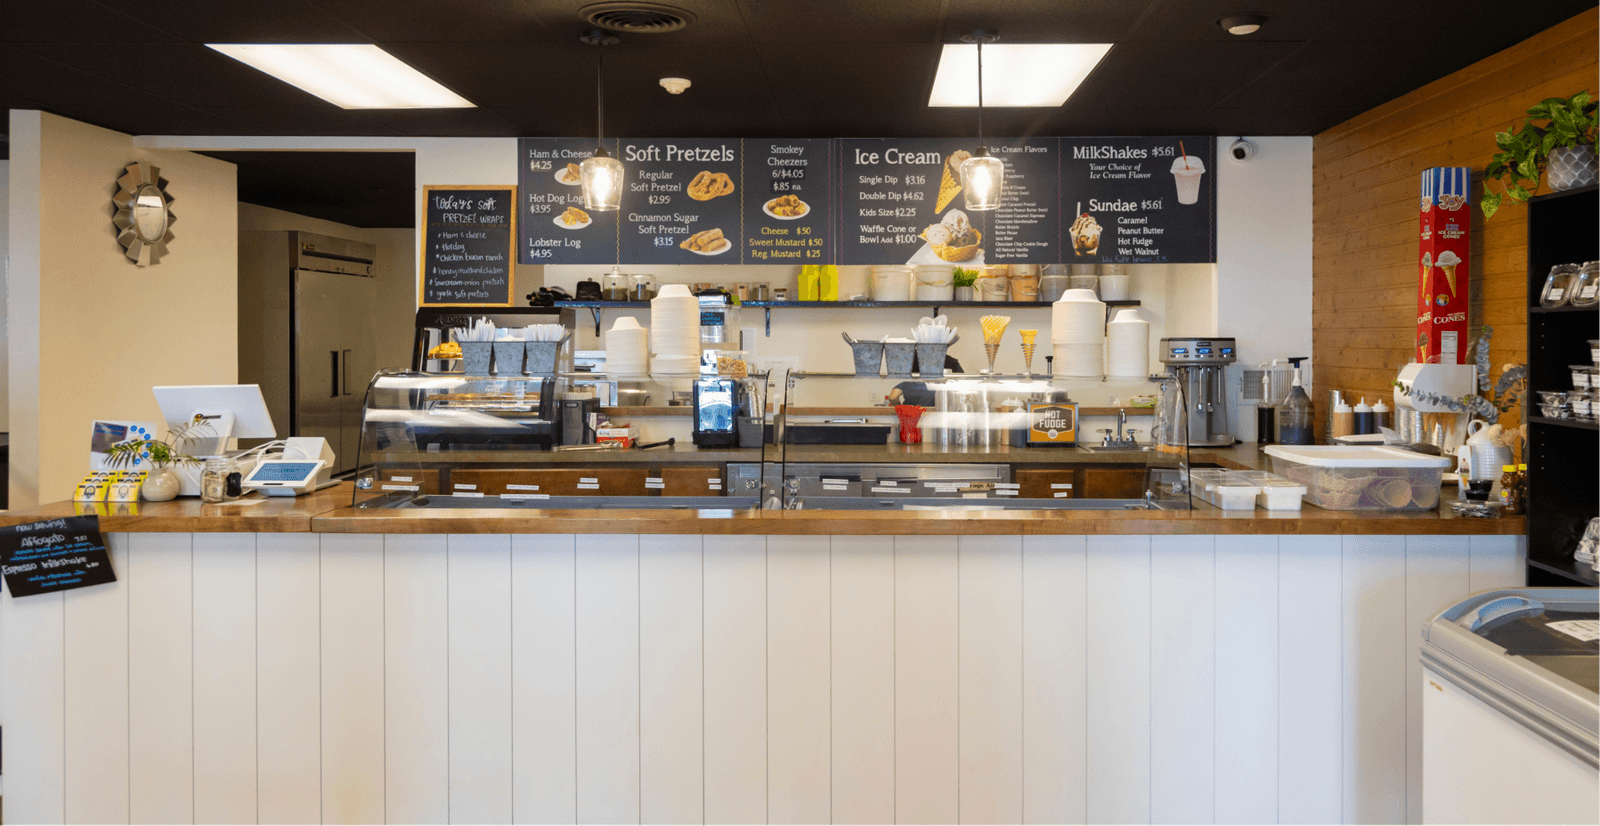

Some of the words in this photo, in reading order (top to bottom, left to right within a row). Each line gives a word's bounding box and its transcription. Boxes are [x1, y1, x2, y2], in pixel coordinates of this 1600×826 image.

[530, 150, 550, 158] Ham
[552, 150, 559, 158] &
[560, 150, 592, 158] Cheese
[626, 145, 660, 161] Soft
[666, 145, 734, 161] Pretzels
[770, 145, 804, 156] Smokey
[1073, 146, 1147, 159] MilkShakes
[1152, 146, 1175, 157] $5.61
[855, 149, 879, 164] Ice
[885, 148, 941, 164] Cream
[530, 161, 552, 170] $4.25
[767, 157, 808, 166] Cheezers
[1134, 163, 1142, 171] of
[639, 171, 673, 181] Regular
[772, 169, 804, 179] 6/$4.05
[859, 176, 882, 185] Single
[884, 176, 898, 185] Dip
[905, 176, 925, 185] $3.16
[631, 183, 649, 192] Soft
[651, 183, 681, 192] Pretzel
[773, 182, 789, 192] $.85
[530, 194, 545, 202] Hot
[548, 194, 566, 204] Dog
[567, 194, 584, 204] Log
[648, 196, 670, 205] $2.95
[859, 192, 887, 200] Double
[889, 192, 902, 202] Dip
[903, 192, 924, 201] $4.62
[433, 195, 473, 210] today's
[478, 198, 496, 210] soft
[1089, 199, 1138, 212] Sundae
[1141, 200, 1162, 210] $5.61
[1438, 194, 1464, 211] JOY
[530, 205, 551, 214] $3.95
[859, 208, 876, 216] Kids
[878, 208, 894, 216] Size
[895, 208, 916, 218] $2.25
[443, 213, 477, 223] PRETZEL
[480, 215, 504, 223] WRAPS
[629, 213, 671, 222] Cinnamon
[674, 213, 699, 224] Sugar
[638, 225, 657, 234] Soft
[659, 225, 689, 234] Pretzel
[796, 227, 811, 236] $.50
[860, 225, 884, 233] Waffle
[887, 225, 906, 233] Cone
[530, 238, 562, 247] Lobster
[565, 238, 581, 249] Log
[654, 237, 674, 247] $3.15
[749, 238, 773, 246] Sweet
[775, 238, 805, 246] Mustard
[808, 238, 823, 247] $.50
[859, 235, 879, 244] Bowl
[895, 234, 917, 244] $1.00
[1132, 238, 1153, 247] Fudge
[530, 249, 552, 258] $4.95
[752, 250, 769, 259] Reg.
[806, 250, 820, 258] $.25
[1434, 315, 1465, 324] CONES
[1045, 410, 1060, 418] HOT
[1040, 419, 1066, 428] FUDGE
[16, 524, 32, 532] now
[21, 533, 65, 547] Affogato
